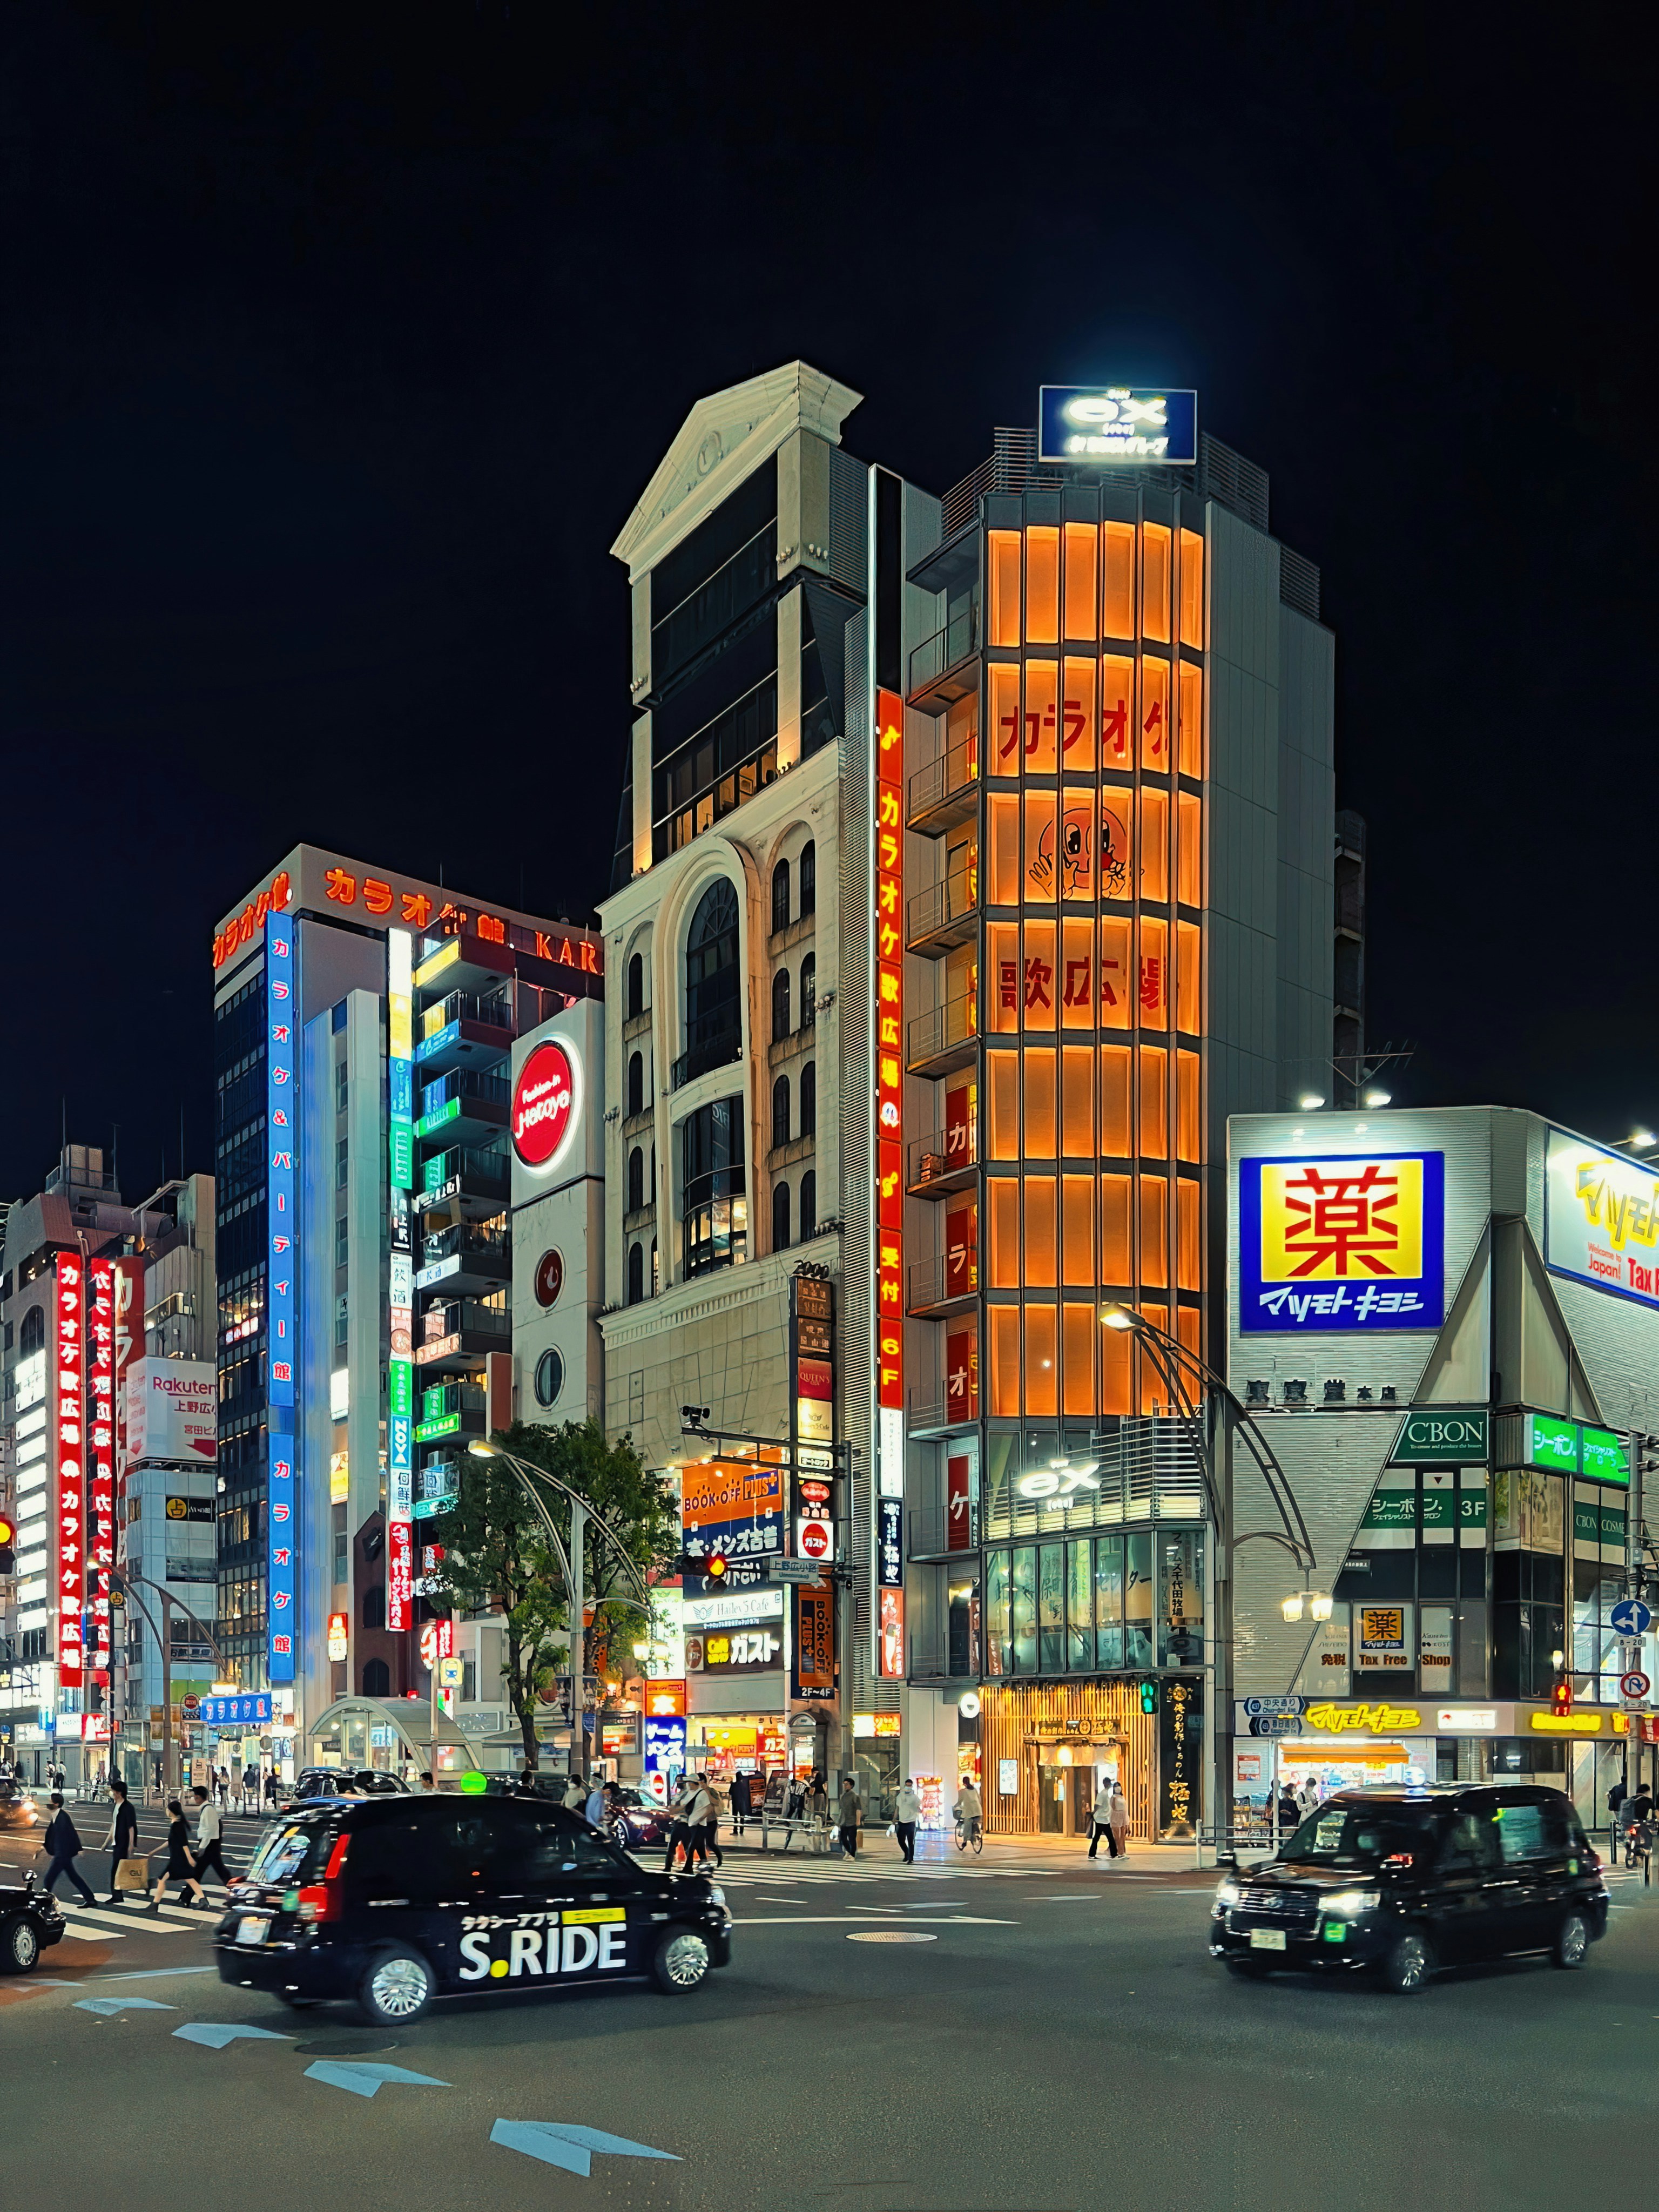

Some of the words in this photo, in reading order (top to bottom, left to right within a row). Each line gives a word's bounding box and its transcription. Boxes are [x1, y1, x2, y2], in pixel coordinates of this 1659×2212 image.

[1285, 1166, 1398, 1277] 薬
[1588, 1253, 1621, 1280] Japan!
[1627, 1257, 1653, 1294] Tax
[1259, 1285, 1425, 1321] マツモトキヨシ
[394, 1420, 407, 1464] NOVA
[1461, 1500, 1485, 1516] 3F
[1367, 1611, 1398, 1639] 薬
[731, 1633, 780, 1664] ガスト
[1359, 1654, 1379, 1665] Tax
[1384, 1654, 1408, 1665] Free
[1422, 1654, 1451, 1667] Shop
[459, 1923, 626, 1980] S.RIDE
